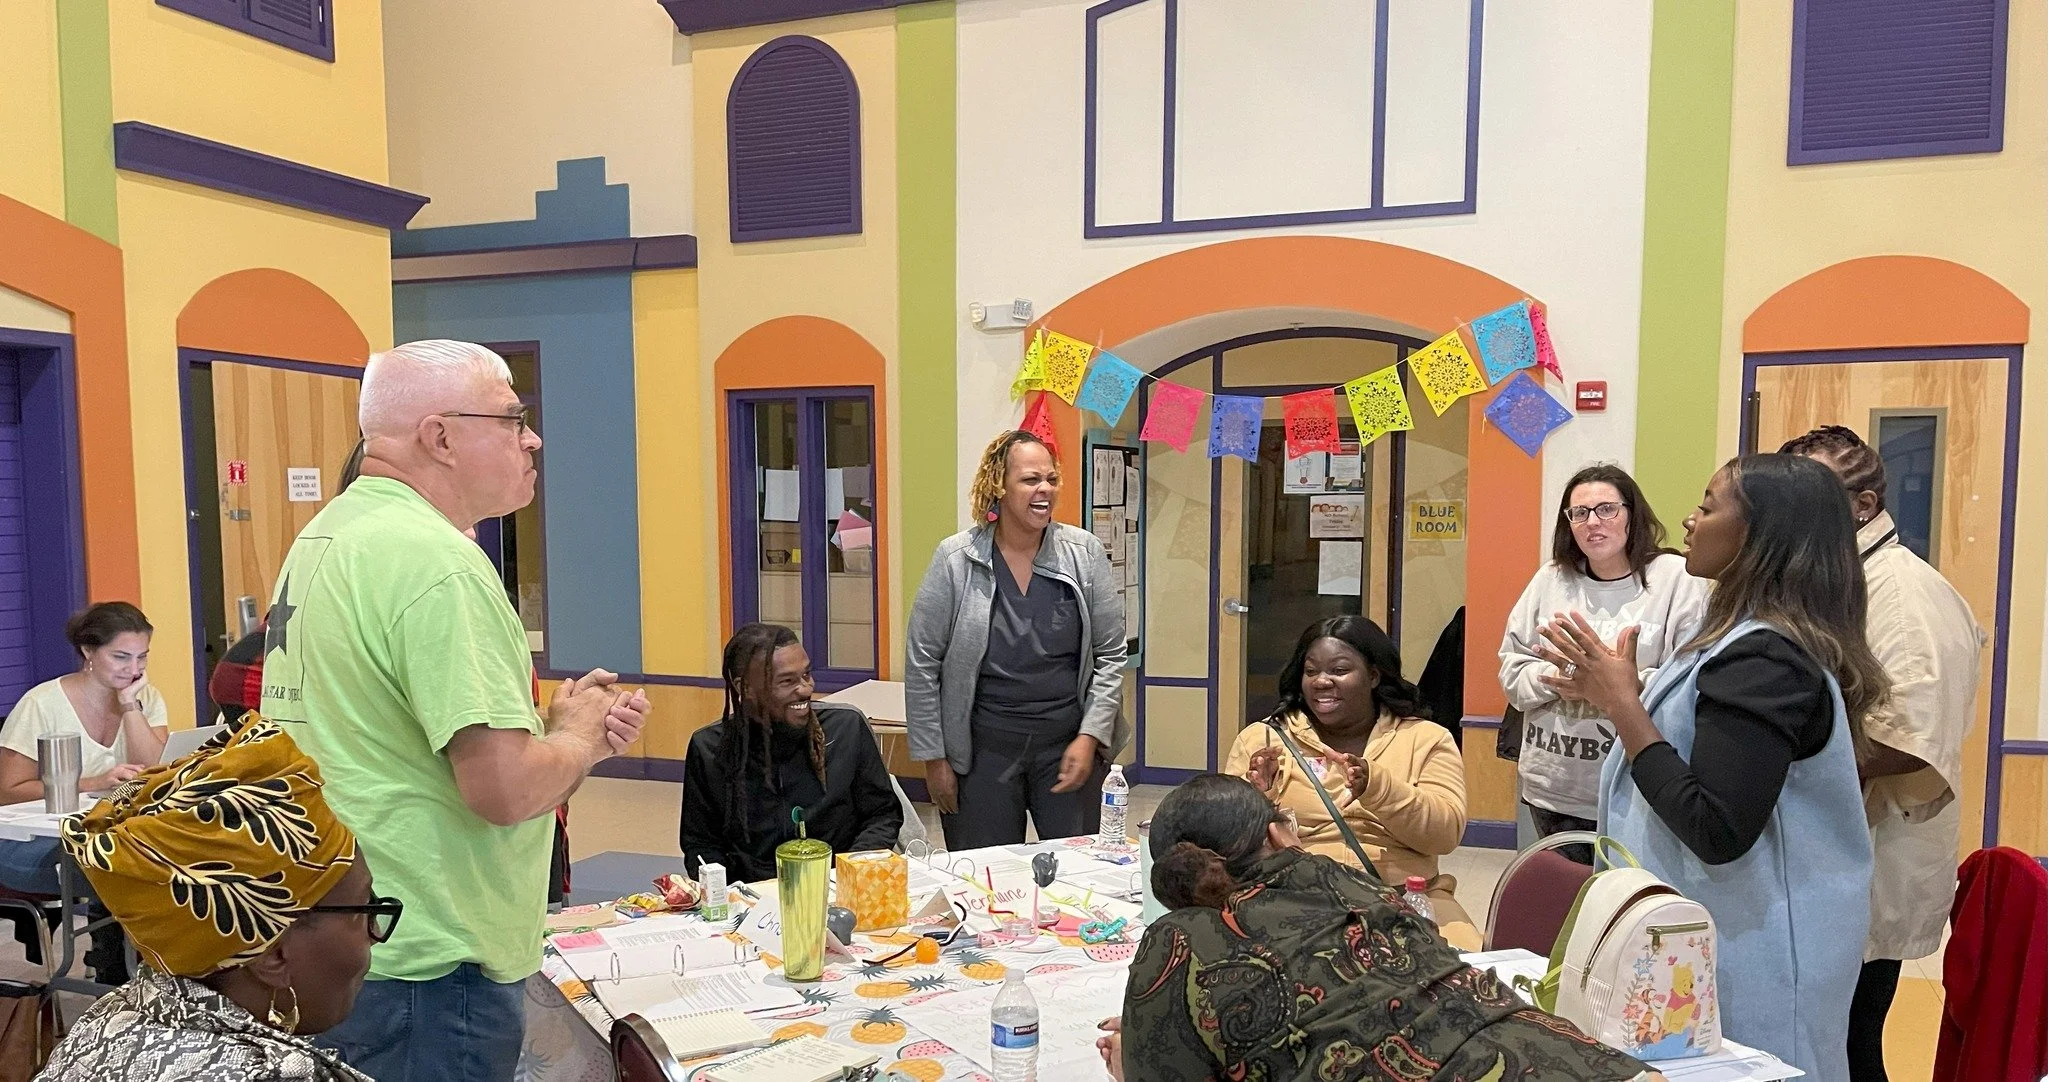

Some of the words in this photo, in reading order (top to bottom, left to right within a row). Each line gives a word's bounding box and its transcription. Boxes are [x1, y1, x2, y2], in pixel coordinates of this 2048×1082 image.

[1419, 505, 1455, 517] BLUE
[1416, 521, 1457, 533] ROOM
[1525, 722, 1613, 761] PLAYB
